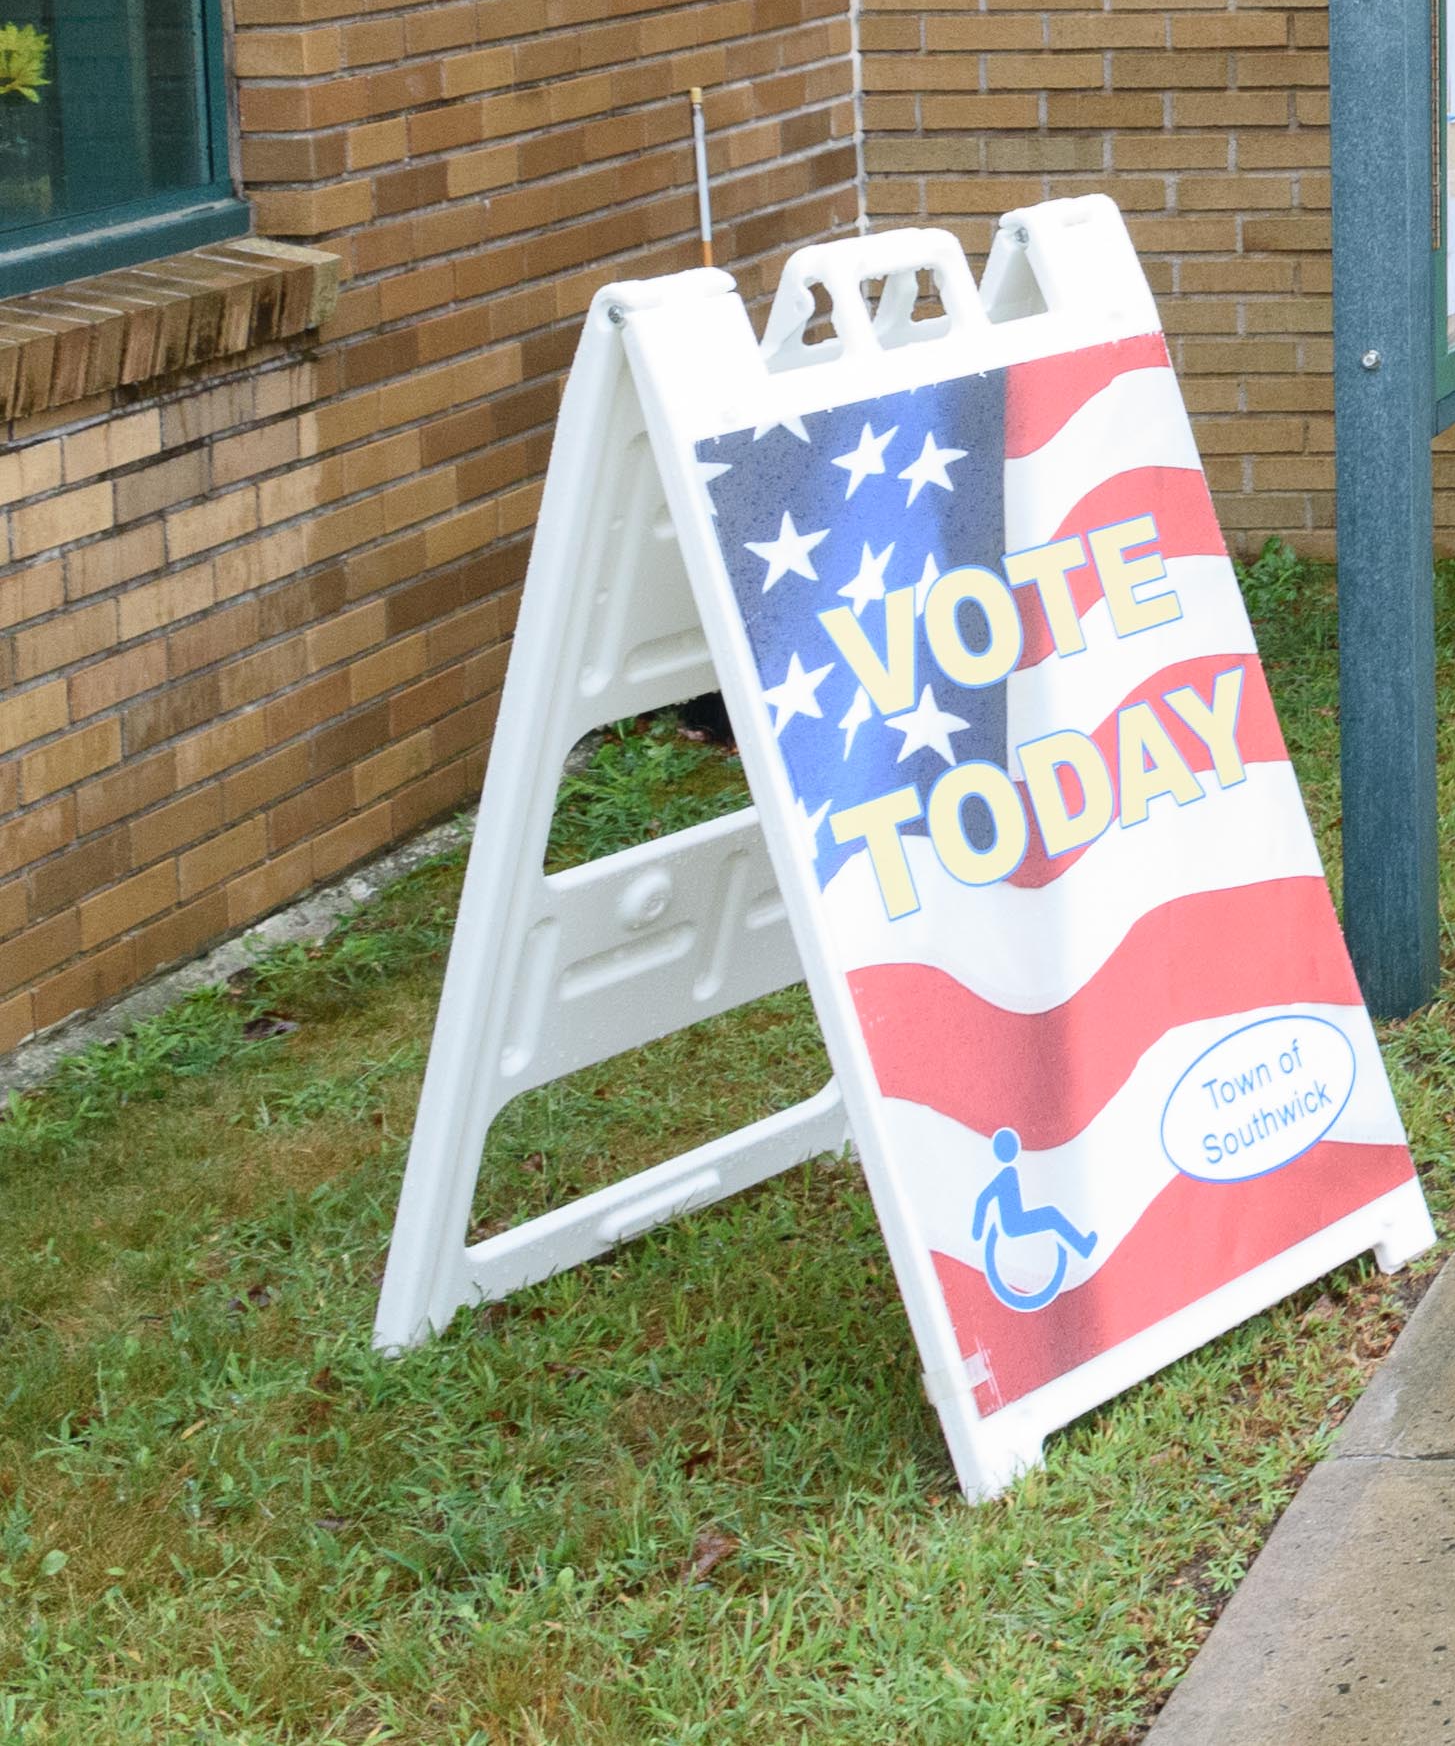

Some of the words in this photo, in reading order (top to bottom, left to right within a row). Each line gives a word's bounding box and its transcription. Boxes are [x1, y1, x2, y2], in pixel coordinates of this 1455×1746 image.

[817, 512, 1183, 717] VOTE
[829, 665, 1248, 922] TODAY
[1201, 1063, 1273, 1110] Town
[1279, 1038, 1303, 1074] of
[1202, 1079, 1333, 1164] Southwick
